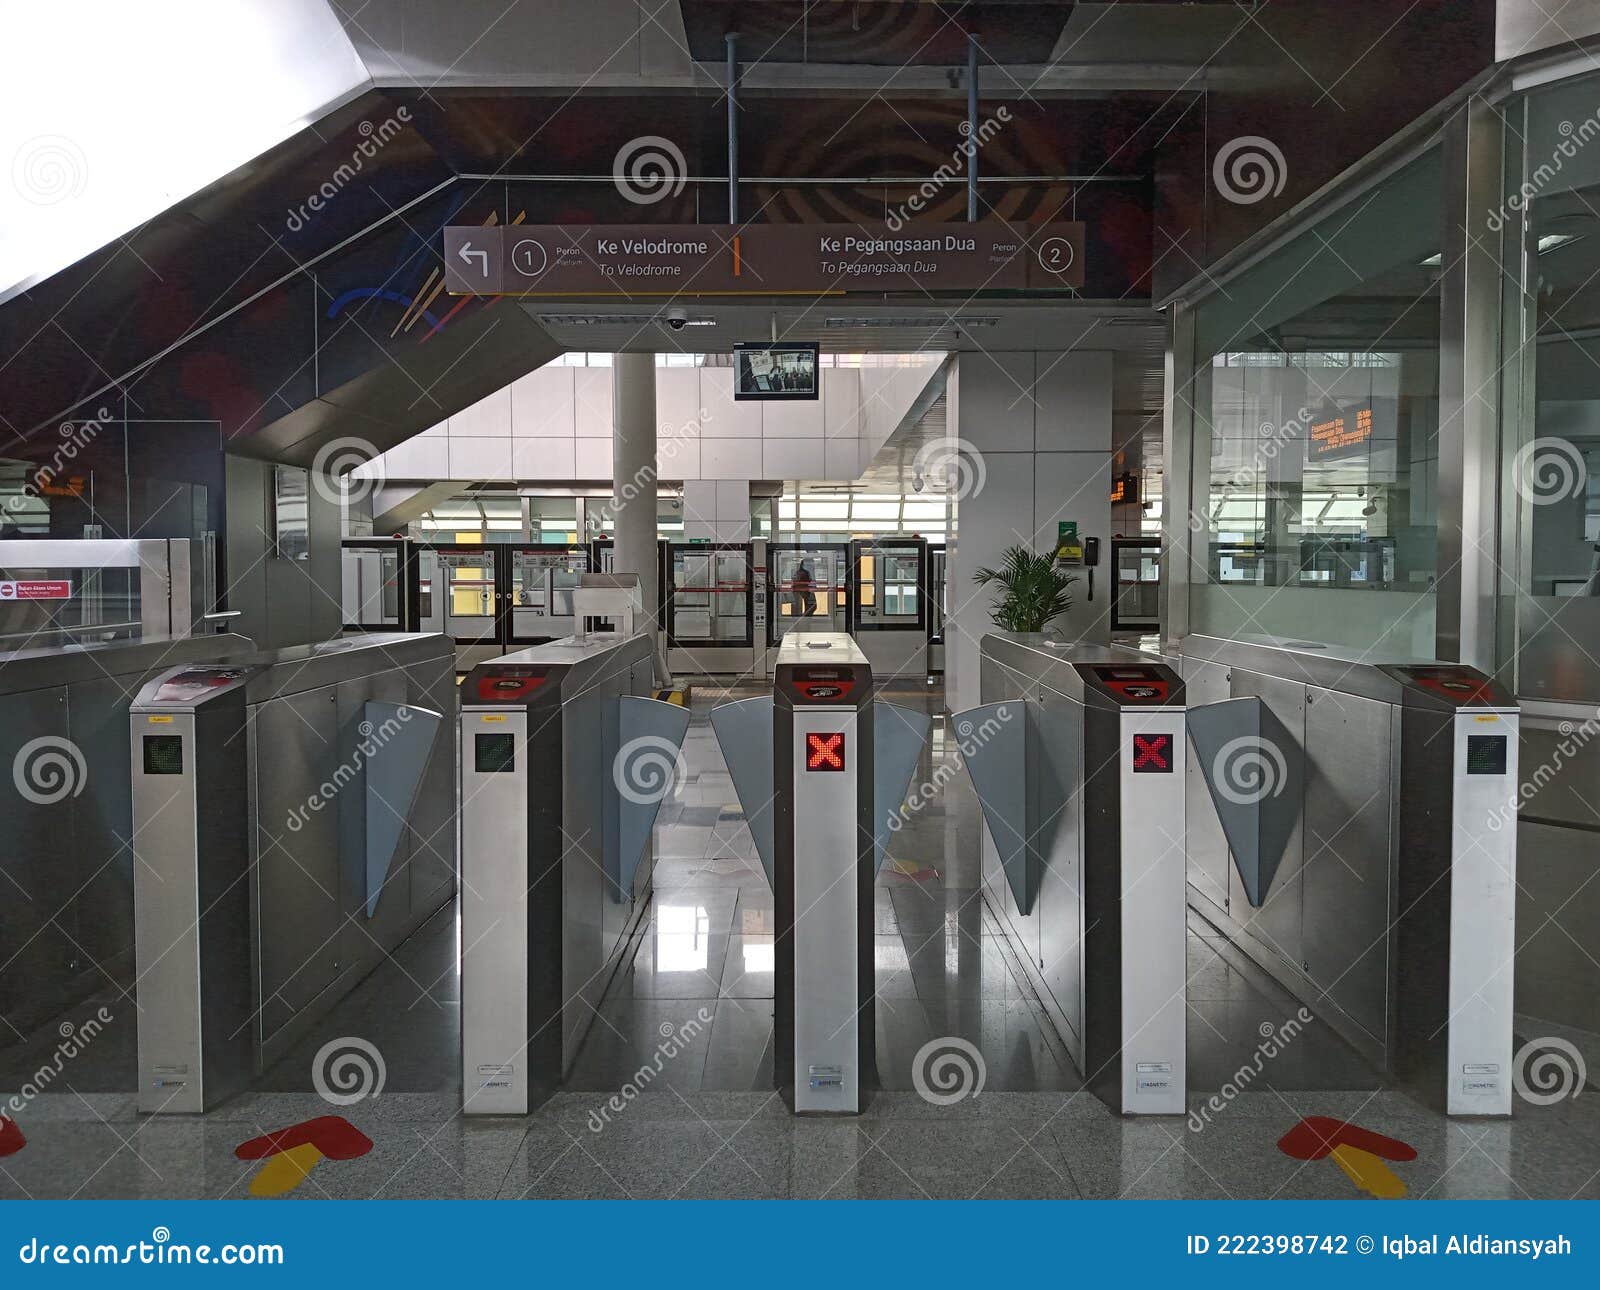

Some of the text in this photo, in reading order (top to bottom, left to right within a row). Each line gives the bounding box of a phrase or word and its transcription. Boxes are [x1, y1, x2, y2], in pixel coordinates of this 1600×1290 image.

[556, 247, 580, 255] Peron
[597, 239, 708, 254] Ke Velodrome
[820, 236, 976, 255] Ke Pegangsaan Dua
[992, 243, 1017, 251] Peron
[600, 264, 681, 276] To Velodrome
[821, 261, 937, 276] To Pegangsaan Dua
